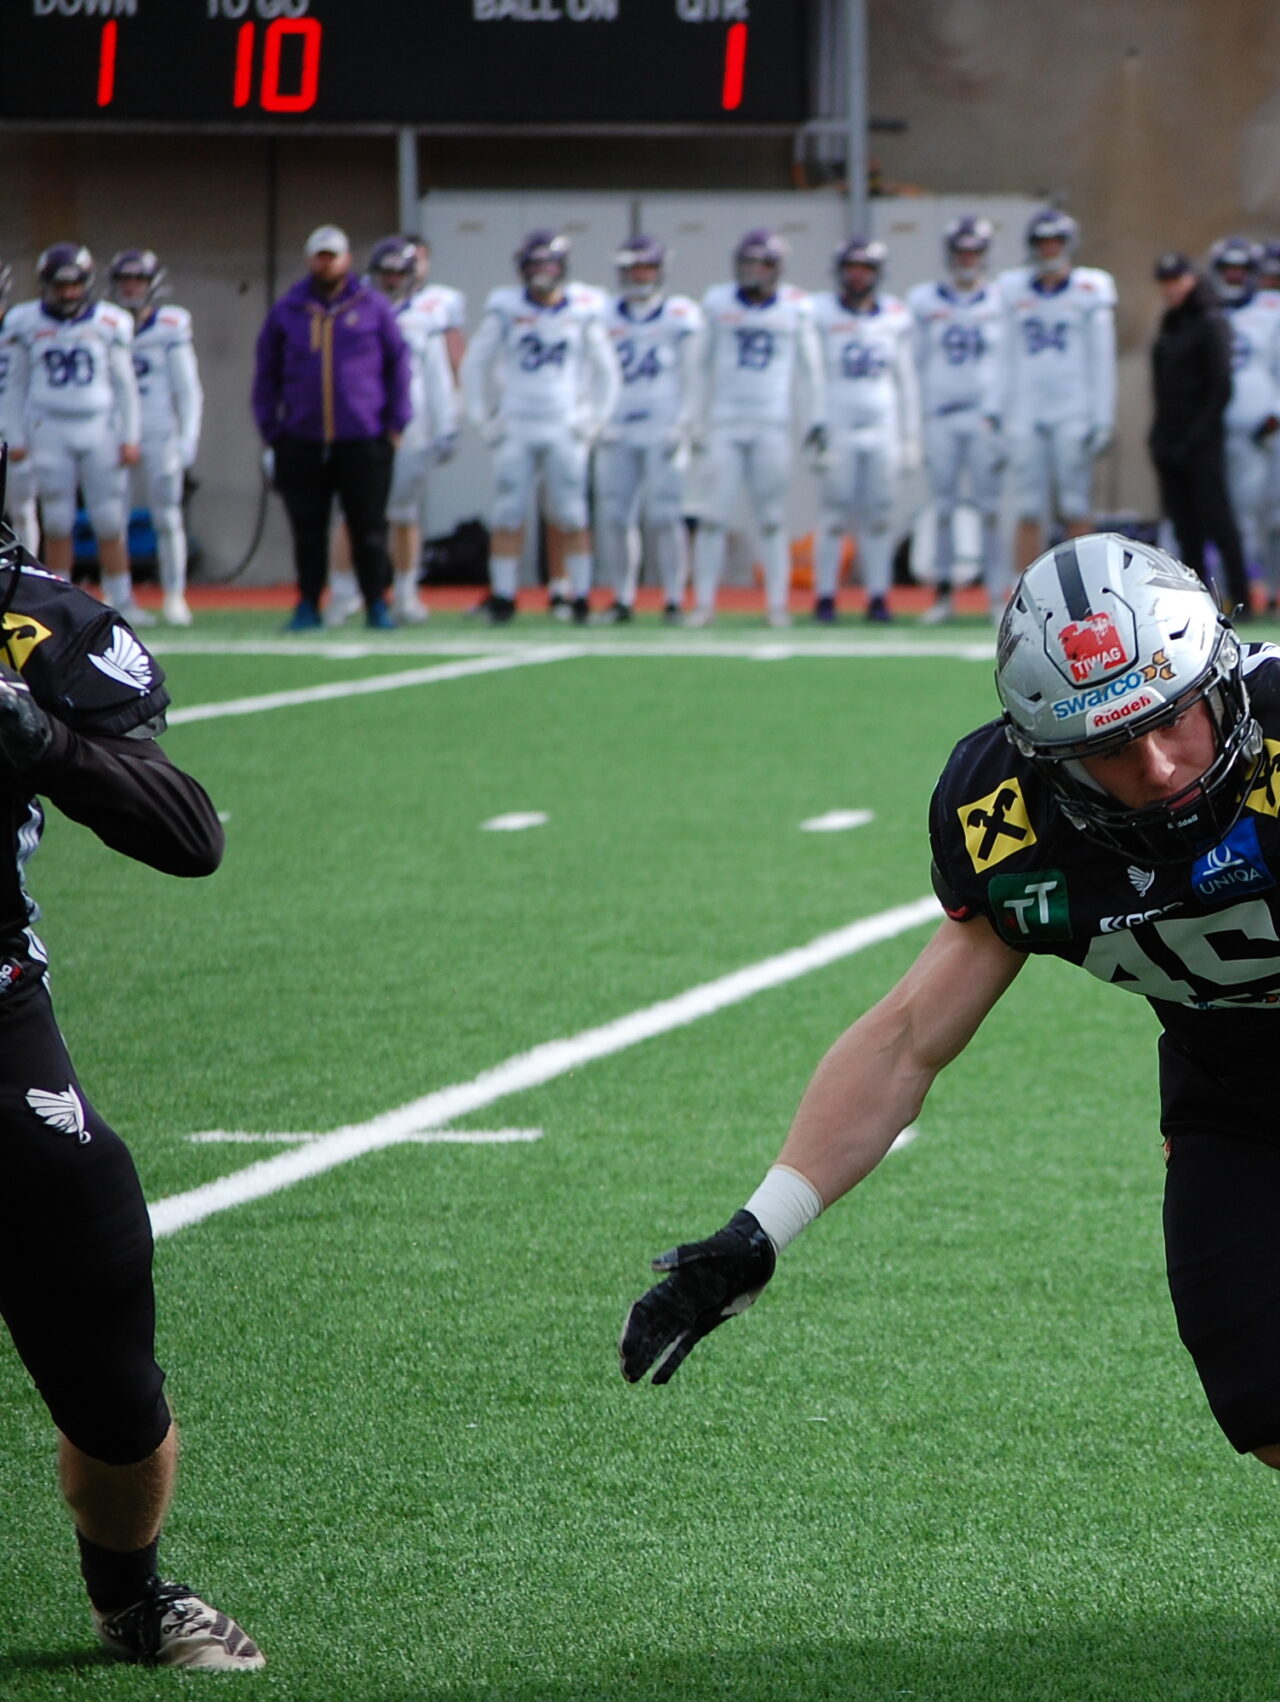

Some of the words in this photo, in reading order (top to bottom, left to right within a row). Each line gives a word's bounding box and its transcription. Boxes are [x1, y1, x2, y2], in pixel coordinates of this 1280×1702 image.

[33, 0, 138, 16] DOWN
[207, 0, 248, 18] TO
[255, 0, 310, 19] GO
[473, 0, 562, 21] BALL
[565, 0, 619, 21] ON
[676, 0, 749, 22] QTR
[97, 19, 118, 107] 1
[233, 17, 322, 112] 10
[721, 22, 747, 110] 1
[1074, 647, 1122, 677] TIWAG
[1052, 671, 1143, 719] swarco
[1166, 813, 1199, 829] Rddell
[1199, 867, 1262, 895] UNIQA
